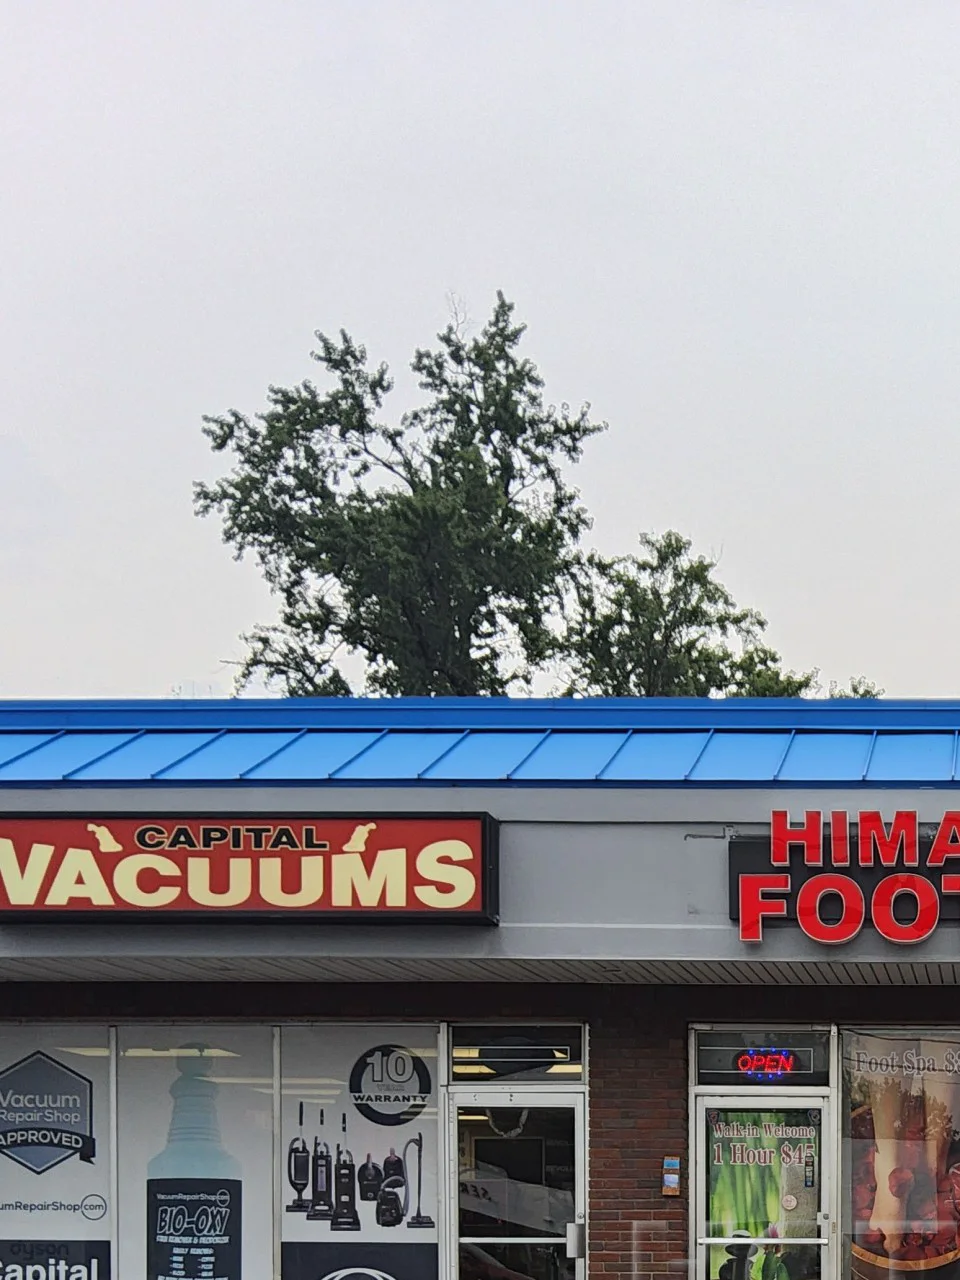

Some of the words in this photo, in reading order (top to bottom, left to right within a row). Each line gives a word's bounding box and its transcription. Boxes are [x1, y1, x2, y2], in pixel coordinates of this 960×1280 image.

[134, 824, 330, 851] CAPITAL
[0, 837, 476, 909] VACUUMS
[366, 1050, 416, 1084] 10
[738, 1055, 794, 1072] OPEN
[855, 1050, 899, 1074] Foot
[902, 1048, 937, 1077] Spa
[0, 1089, 80, 1108] Vacuum
[353, 1094, 428, 1103] WARRANTY
[0, 1130, 83, 1148] APPROVED
[714, 1121, 760, 1138] Walk-in
[762, 1122, 816, 1138] Welcome
[714, 1142, 723, 1165] 1
[730, 1143, 776, 1165] Hour
[157, 1206, 230, 1236] BIO-OXY
